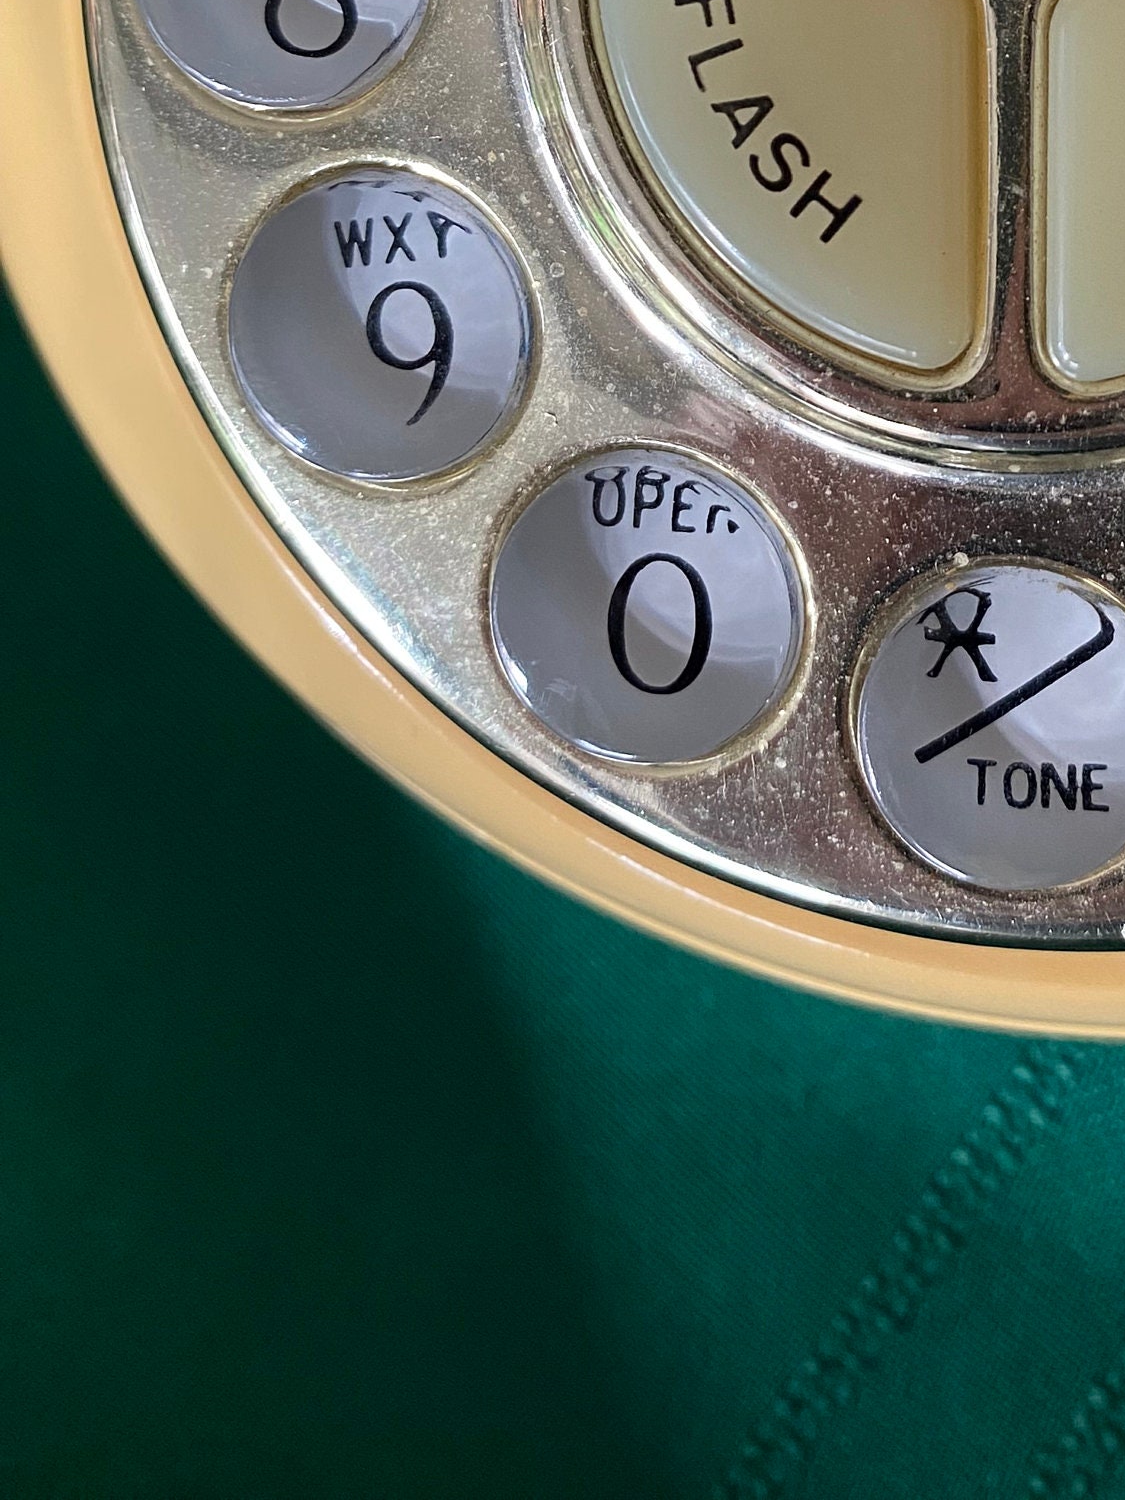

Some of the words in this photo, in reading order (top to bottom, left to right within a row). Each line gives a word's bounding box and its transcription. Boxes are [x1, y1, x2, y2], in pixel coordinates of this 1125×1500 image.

[333, 212, 466, 268] WXY
[365, 281, 453, 426] 9
[607, 553, 713, 696] 0
[967, 758, 1110, 813] TONE
